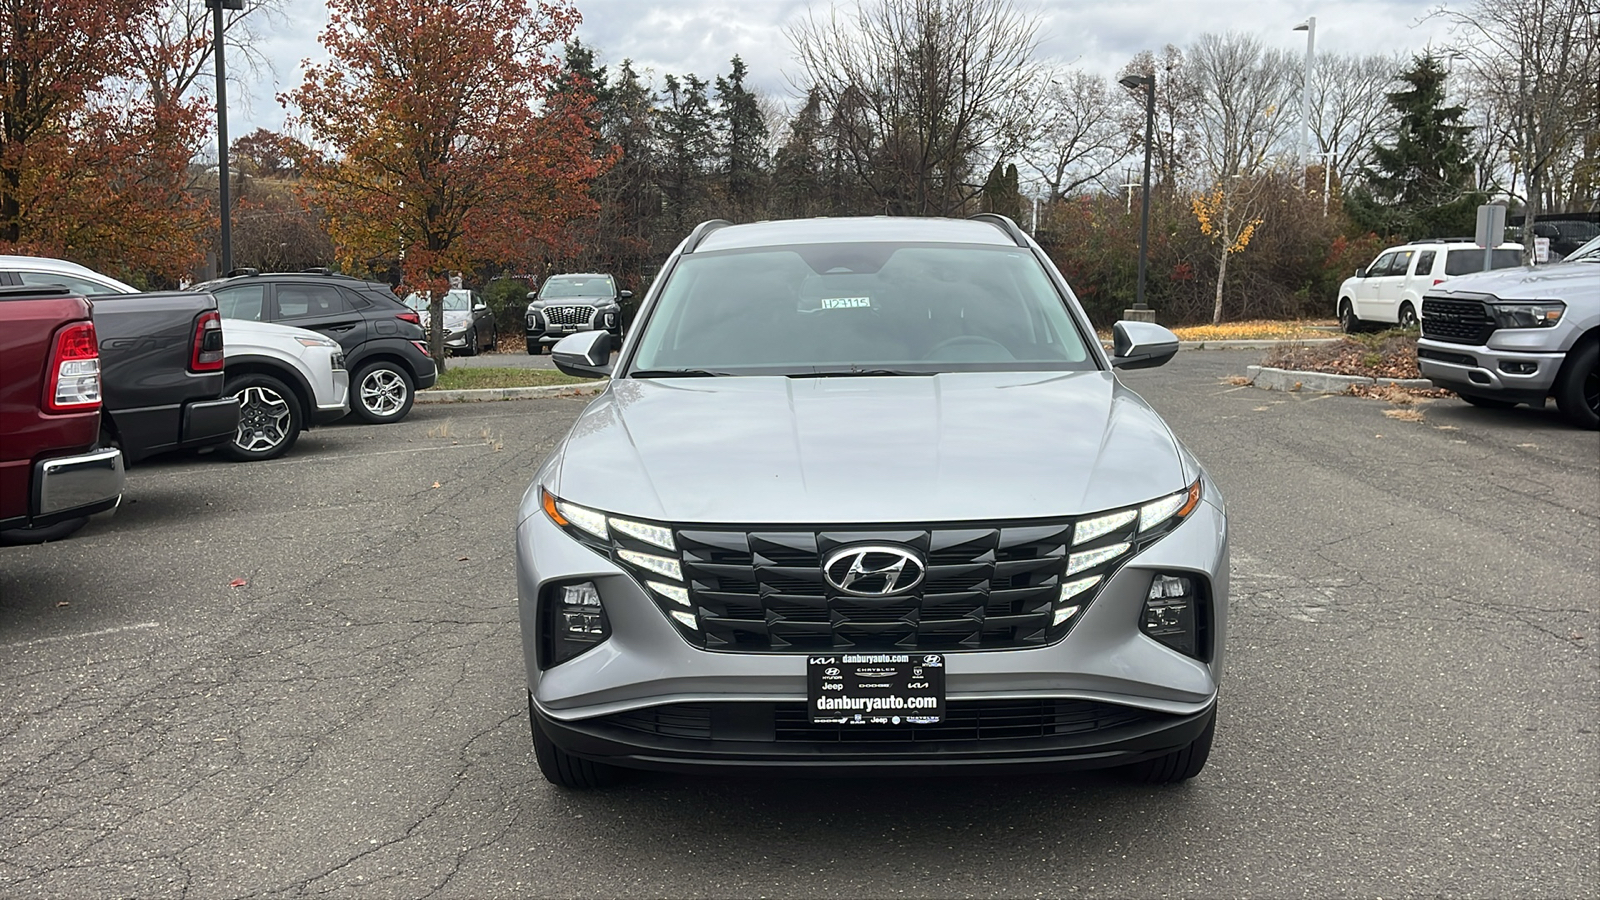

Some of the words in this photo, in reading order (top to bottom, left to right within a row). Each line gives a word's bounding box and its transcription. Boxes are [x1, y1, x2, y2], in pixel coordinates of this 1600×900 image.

[842, 654, 909, 664] danburyauto.com
[821, 682, 844, 691] Jeep
[817, 695, 937, 712] danburyauto.com
[870, 716, 888, 724] Jeep
